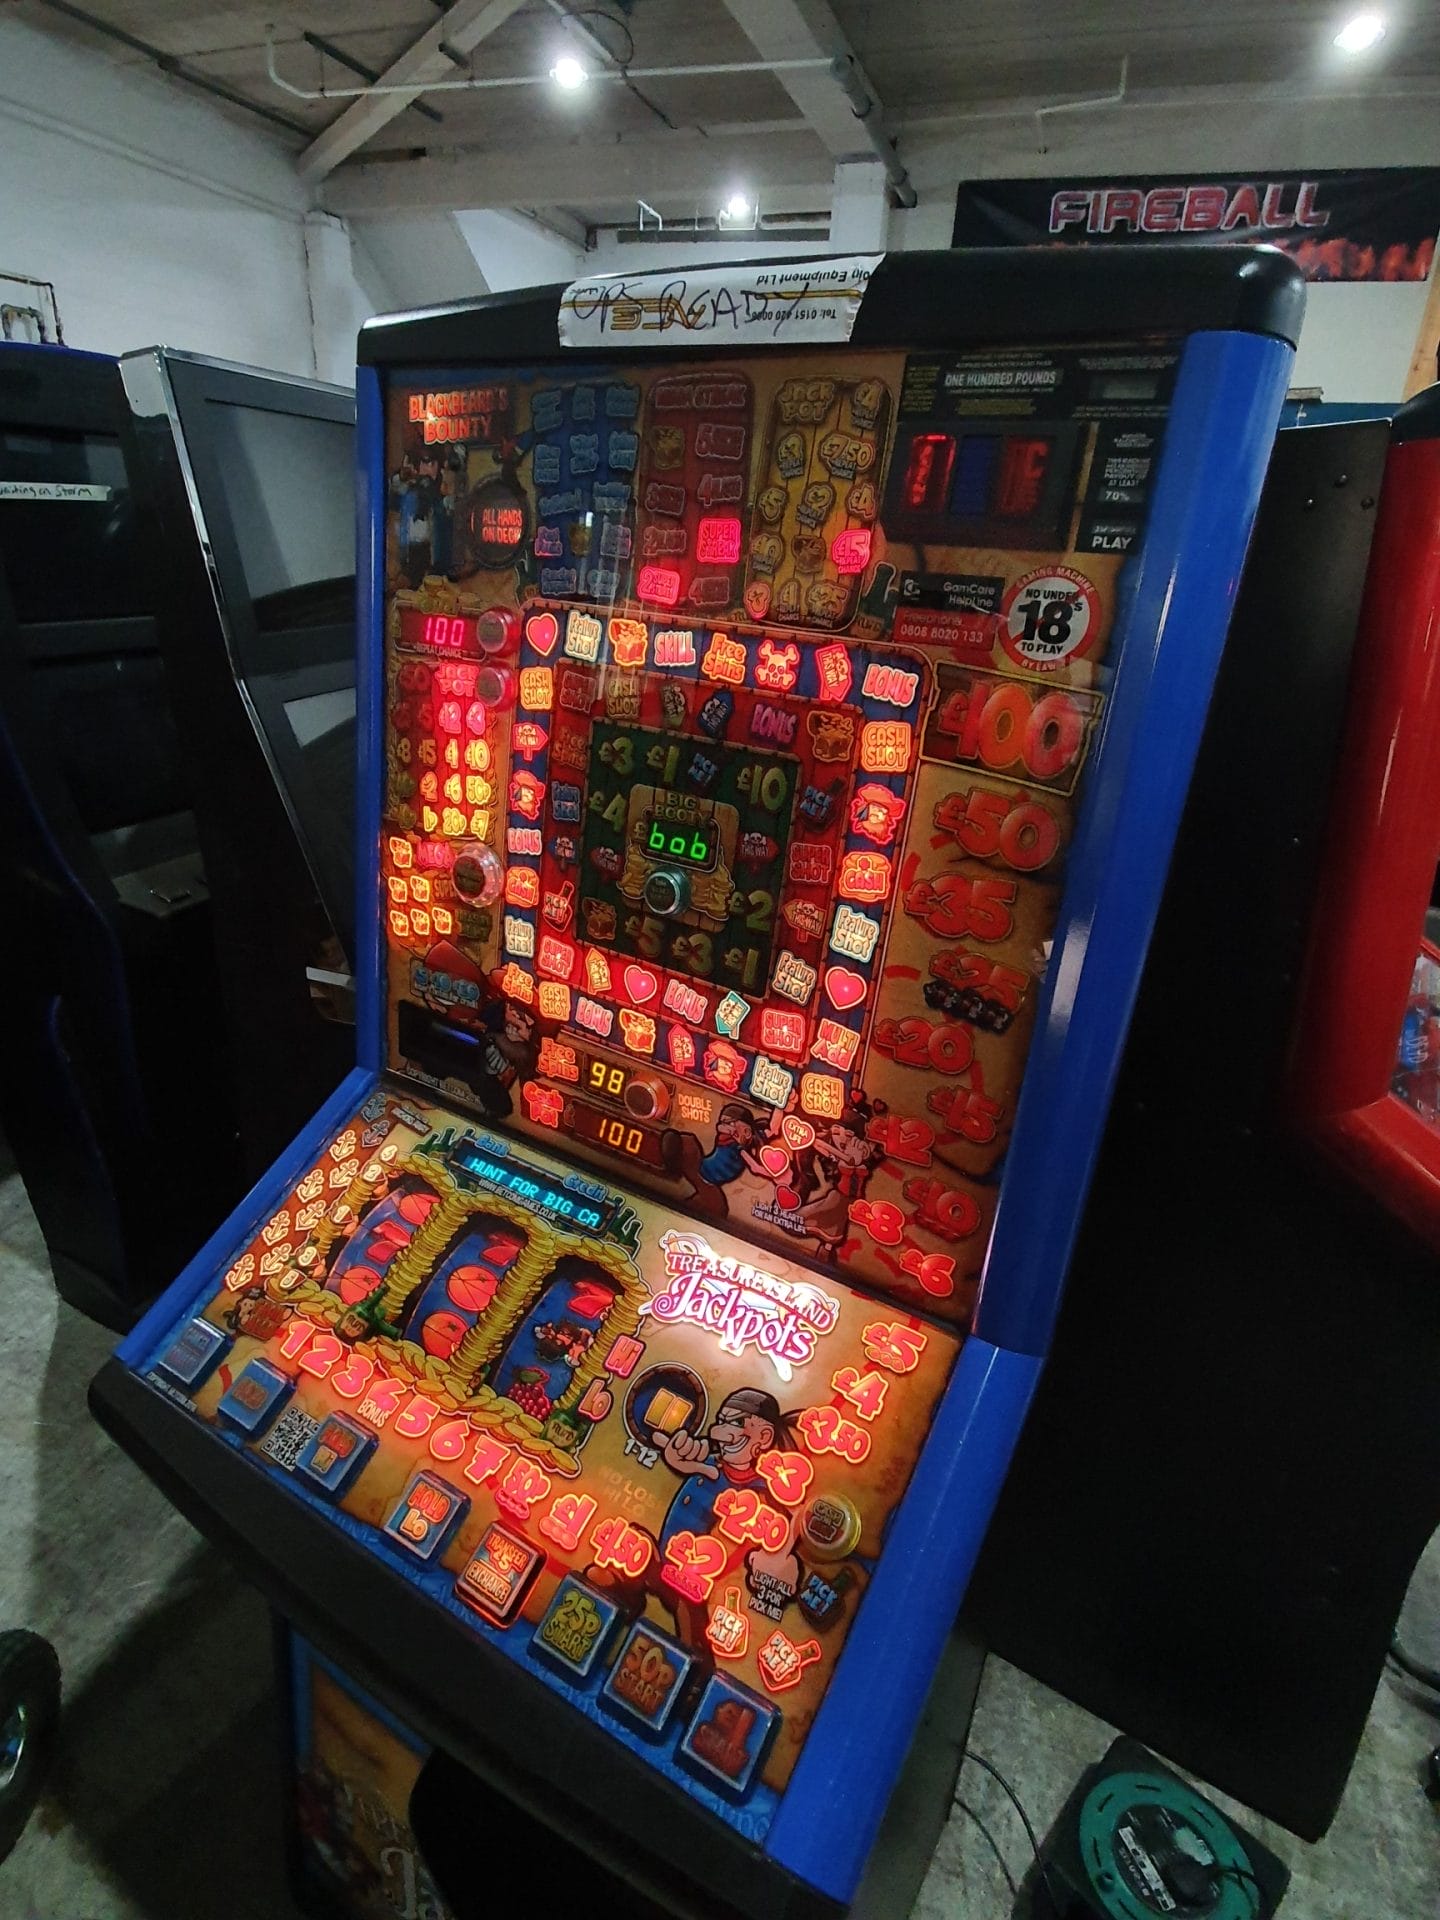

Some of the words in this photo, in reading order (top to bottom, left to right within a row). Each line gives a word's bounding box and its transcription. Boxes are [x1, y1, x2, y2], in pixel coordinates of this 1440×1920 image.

[1049, 183, 1331, 233] FIREBALL
[756, 272, 777, 285] Ltd
[778, 269, 847, 285] Equipment
[796, 309, 818, 321] 0151
[819, 309, 838, 321] Tel:
[944, 373, 965, 387] ONE
[967, 371, 1013, 386] HUNDRED
[1015, 371, 1057, 385] POUNDS
[782, 401, 826, 421] POT
[423, 414, 491, 445] BOUNTY
[1104, 490, 1131, 502] 70%
[482, 508, 496, 526] ALL
[702, 523, 737, 540] SUPER
[481, 526, 496, 544] ON
[835, 533, 869, 558] £15
[1091, 535, 1133, 550] PLAY
[943, 581, 996, 596] GamCare
[1016, 567, 1053, 590] GAMING
[1054, 566, 1097, 595] MACHINE
[1025, 588, 1041, 599] NO
[425, 616, 465, 647] 100
[568, 613, 599, 638] Feature
[901, 624, 927, 637] 0808
[931, 627, 959, 641] 8020
[654, 632, 695, 666] SKILL
[710, 634, 744, 661] Free
[1020, 641, 1035, 652] TO
[1036, 643, 1064, 655] PLAY
[434, 663, 478, 682] JACK
[523, 671, 549, 688] CASH
[703, 653, 742, 682] Spins
[1020, 659, 1034, 669] BY
[1036, 661, 1056, 672] LAW
[437, 679, 475, 697] POT
[523, 689, 549, 706] SHOT
[607, 678, 637, 698] CASH
[863, 664, 916, 707] BONUS
[607, 697, 639, 718] SHOT
[750, 703, 797, 743] BONUS
[866, 724, 906, 746] CASH
[937, 680, 1085, 781] £100
[597, 736, 634, 776] £3
[645, 744, 680, 784] £1
[866, 746, 905, 768] SHOT
[664, 791, 697, 809] BIG
[735, 763, 787, 812] £10
[587, 790, 627, 833] £4
[653, 804, 708, 828] BOOTY
[507, 829, 540, 854] BONUS
[934, 788, 1060, 871] £50
[790, 861, 830, 883] SHOT
[844, 869, 884, 893] CASH
[728, 889, 773, 932] £2
[836, 907, 876, 939] Feature
[834, 931, 871, 960] Shot
[777, 952, 815, 985] Feature
[540, 984, 567, 1001] CASH
[664, 980, 707, 1024] BONUS
[541, 1000, 568, 1021] SHOT
[575, 998, 612, 1037] BONUS
[764, 1012, 800, 1034] SUPER
[763, 1029, 800, 1051] SHOT
[819, 1020, 858, 1051] MULTI
[873, 1016, 976, 1076] £20
[540, 1038, 575, 1064] Free
[537, 1055, 578, 1081] Spins
[590, 1062, 625, 1095] 98
[755, 1060, 789, 1088] Feature
[805, 1077, 842, 1099] CASH
[676, 1094, 712, 1112] DOUBLE
[680, 1107, 710, 1124] SHOTS
[804, 1094, 840, 1116] SHOT
[926, 1086, 1002, 1143] £15
[599, 1118, 644, 1154] 100
[786, 1121, 808, 1139] EXTRA
[866, 1114, 935, 1167] £12
[473, 1134, 511, 1157] Bank
[469, 1157, 508, 1181] HUNT
[510, 1177, 539, 1198] FOR
[544, 1192, 571, 1214] BIG
[577, 1208, 601, 1227] CA
[562, 1173, 607, 1203] Credit
[753, 1200, 772, 1214] LIGHT
[779, 1209, 804, 1225] HEARTS
[903, 1176, 982, 1238] £10
[772, 1216, 792, 1231] EXTRA
[792, 1223, 806, 1235] LIFE
[847, 1199, 905, 1246] £8
[899, 1249, 956, 1297] £6
[667, 1253, 769, 1293] TREASURE
[768, 1279, 832, 1330] ISLAND
[652, 1272, 816, 1364] Jackpots
[280, 1321, 316, 1359] 1
[862, 1322, 929, 1374] £5
[299, 1333, 343, 1379] 2
[332, 1353, 374, 1398] 3
[831, 1366, 890, 1422] £4
[357, 1399, 390, 1428] BONUS
[394, 1395, 441, 1438] 5
[429, 1419, 470, 1461] 6
[797, 1405, 872, 1465] £3.50
[463, 1434, 511, 1484] 7
[624, 1439, 659, 1469] 1-12
[755, 1449, 815, 1506] £3
[408, 1483, 450, 1523] HOLD
[713, 1487, 790, 1552] £2.50
[486, 1533, 530, 1573] TRANSFER
[664, 1530, 728, 1601] £2
[467, 1562, 510, 1602] EXCHANGE
[754, 1570, 777, 1588] LIGHT
[777, 1579, 794, 1597] ALL
[757, 1587, 765, 1600] 3
[765, 1589, 782, 1604] FOR
[809, 1574, 839, 1605] PICK
[714, 1608, 744, 1633] PICK
[749, 1597, 767, 1614] PICK
[767, 1603, 784, 1620] ME!
[543, 1615, 594, 1663] START
[769, 1633, 800, 1668] PICK
[613, 1662, 661, 1709] START
